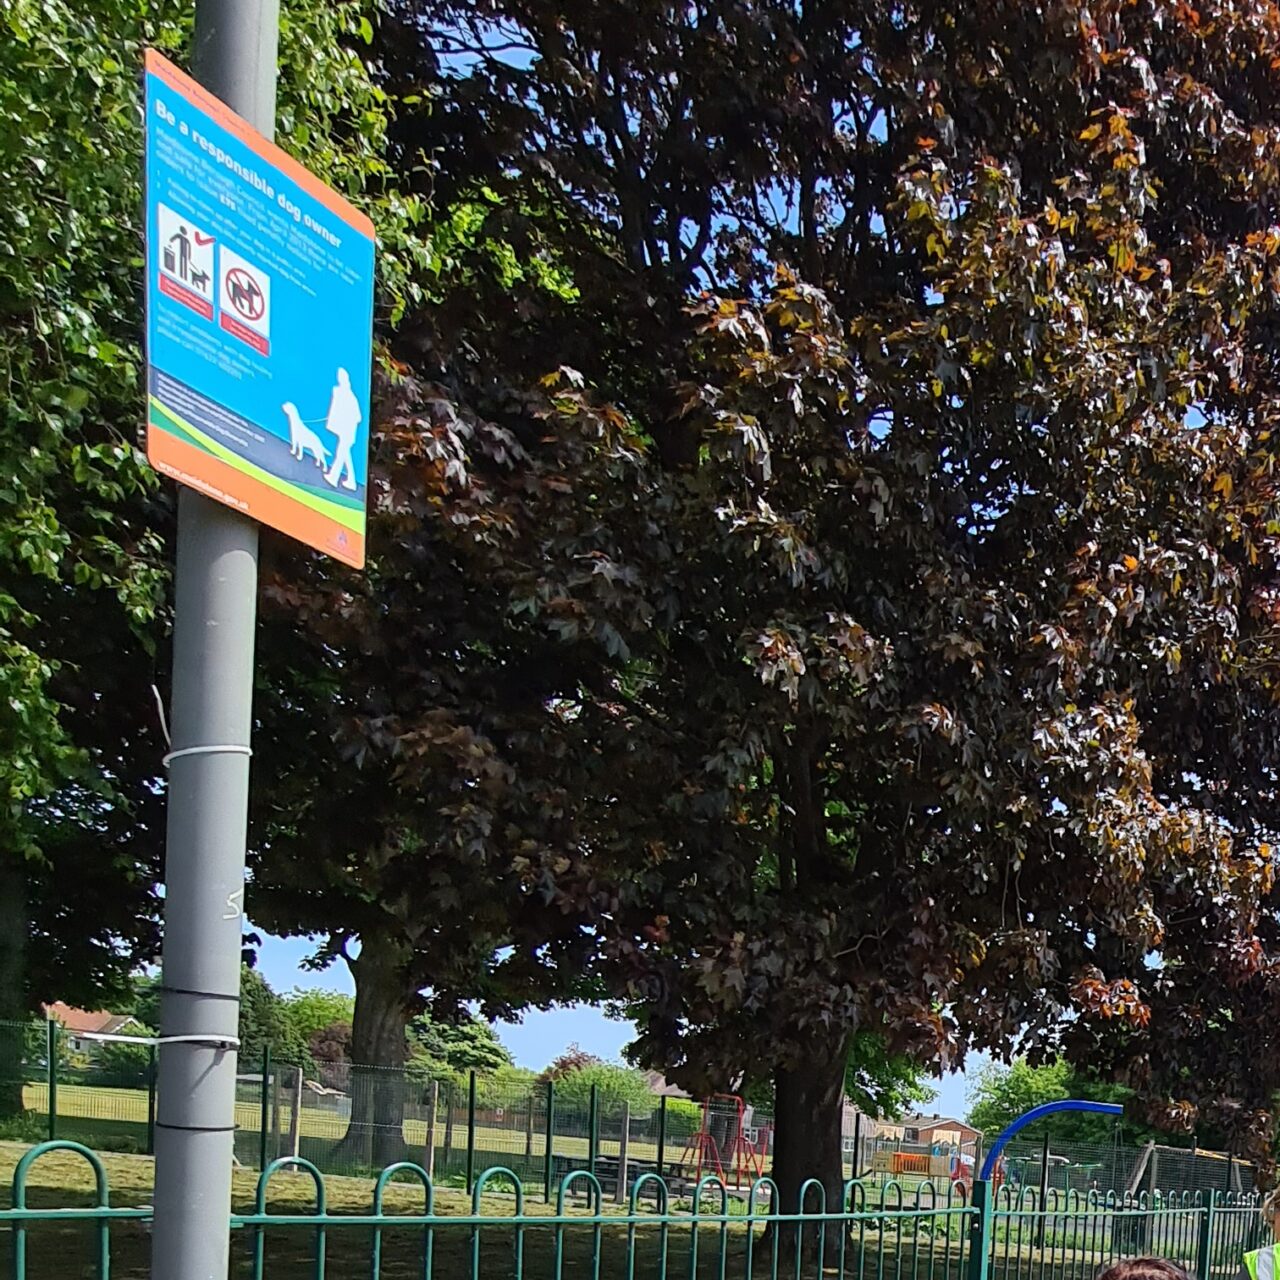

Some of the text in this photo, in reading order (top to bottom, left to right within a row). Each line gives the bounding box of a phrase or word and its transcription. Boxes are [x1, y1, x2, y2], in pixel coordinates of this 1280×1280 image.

[156, 100, 175, 126] Be
[179, 121, 188, 135] a
[192, 131, 274, 199] responsible
[277, 193, 301, 222] dog
[303, 216, 342, 249] owner
